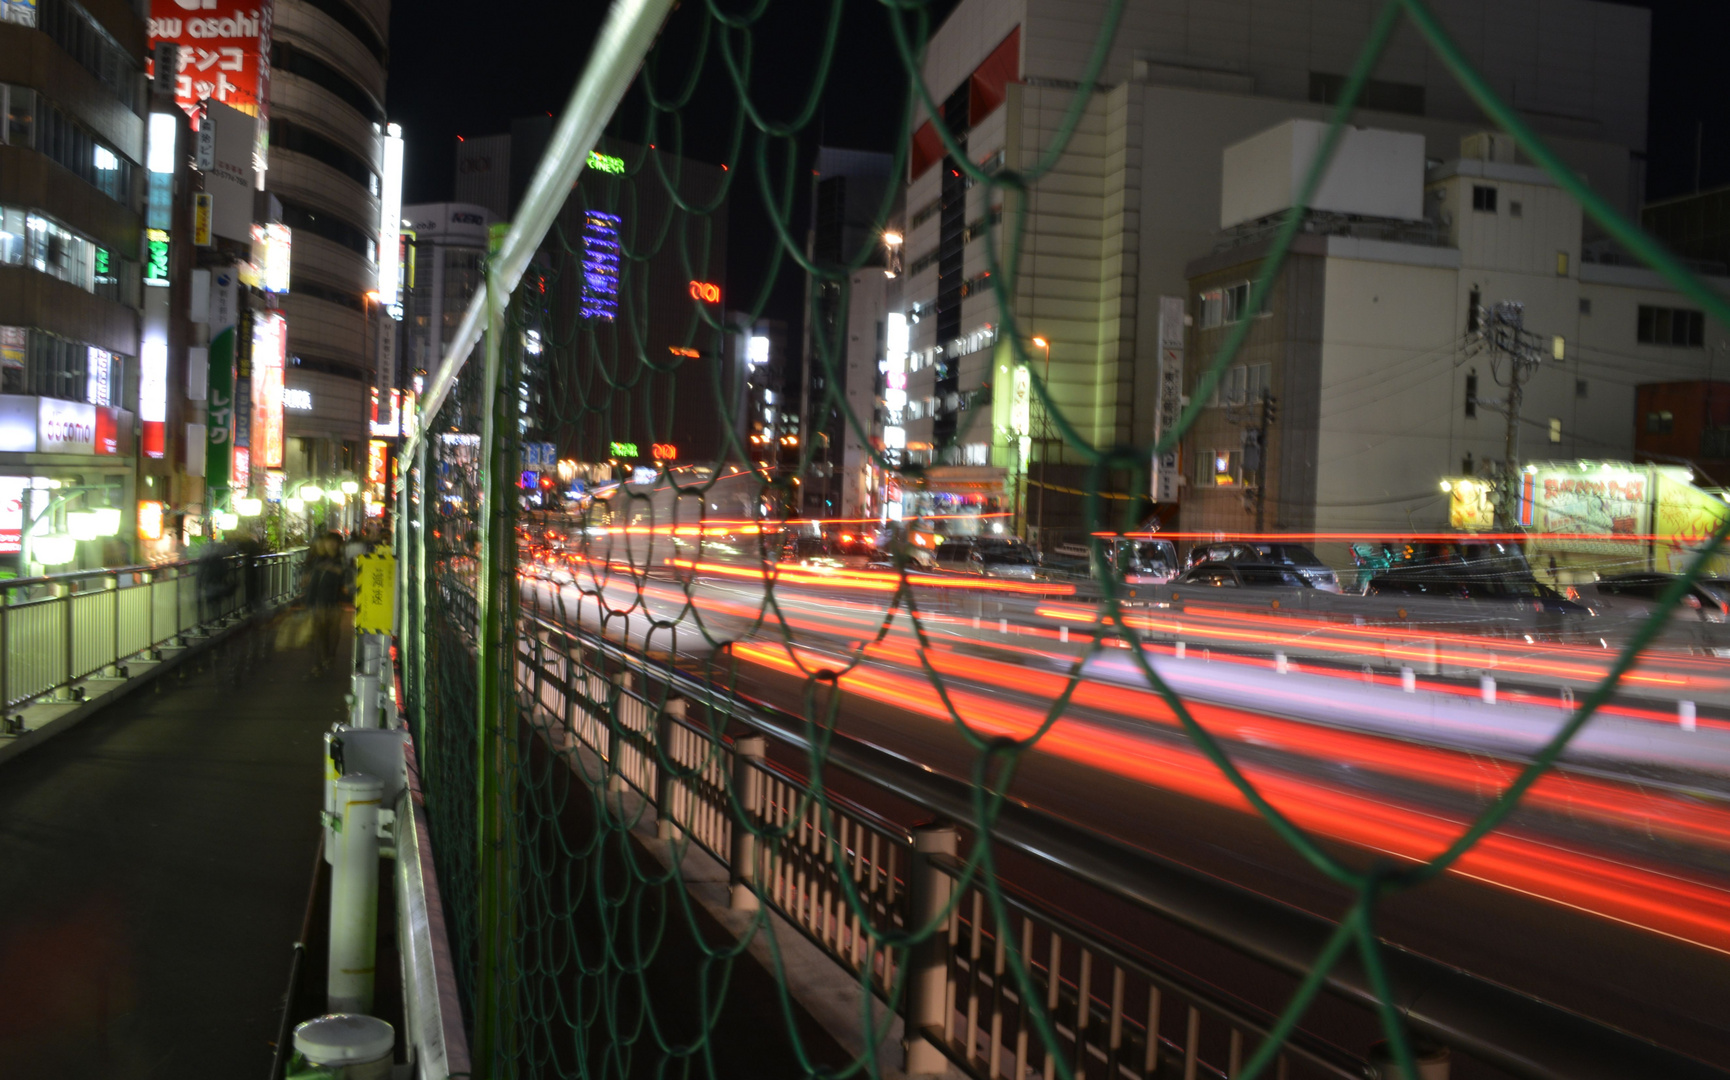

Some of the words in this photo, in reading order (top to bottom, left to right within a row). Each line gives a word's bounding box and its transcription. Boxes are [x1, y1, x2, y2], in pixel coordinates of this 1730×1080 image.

[187, 9, 259, 38] asahi
[210, 389, 230, 444] レイク
